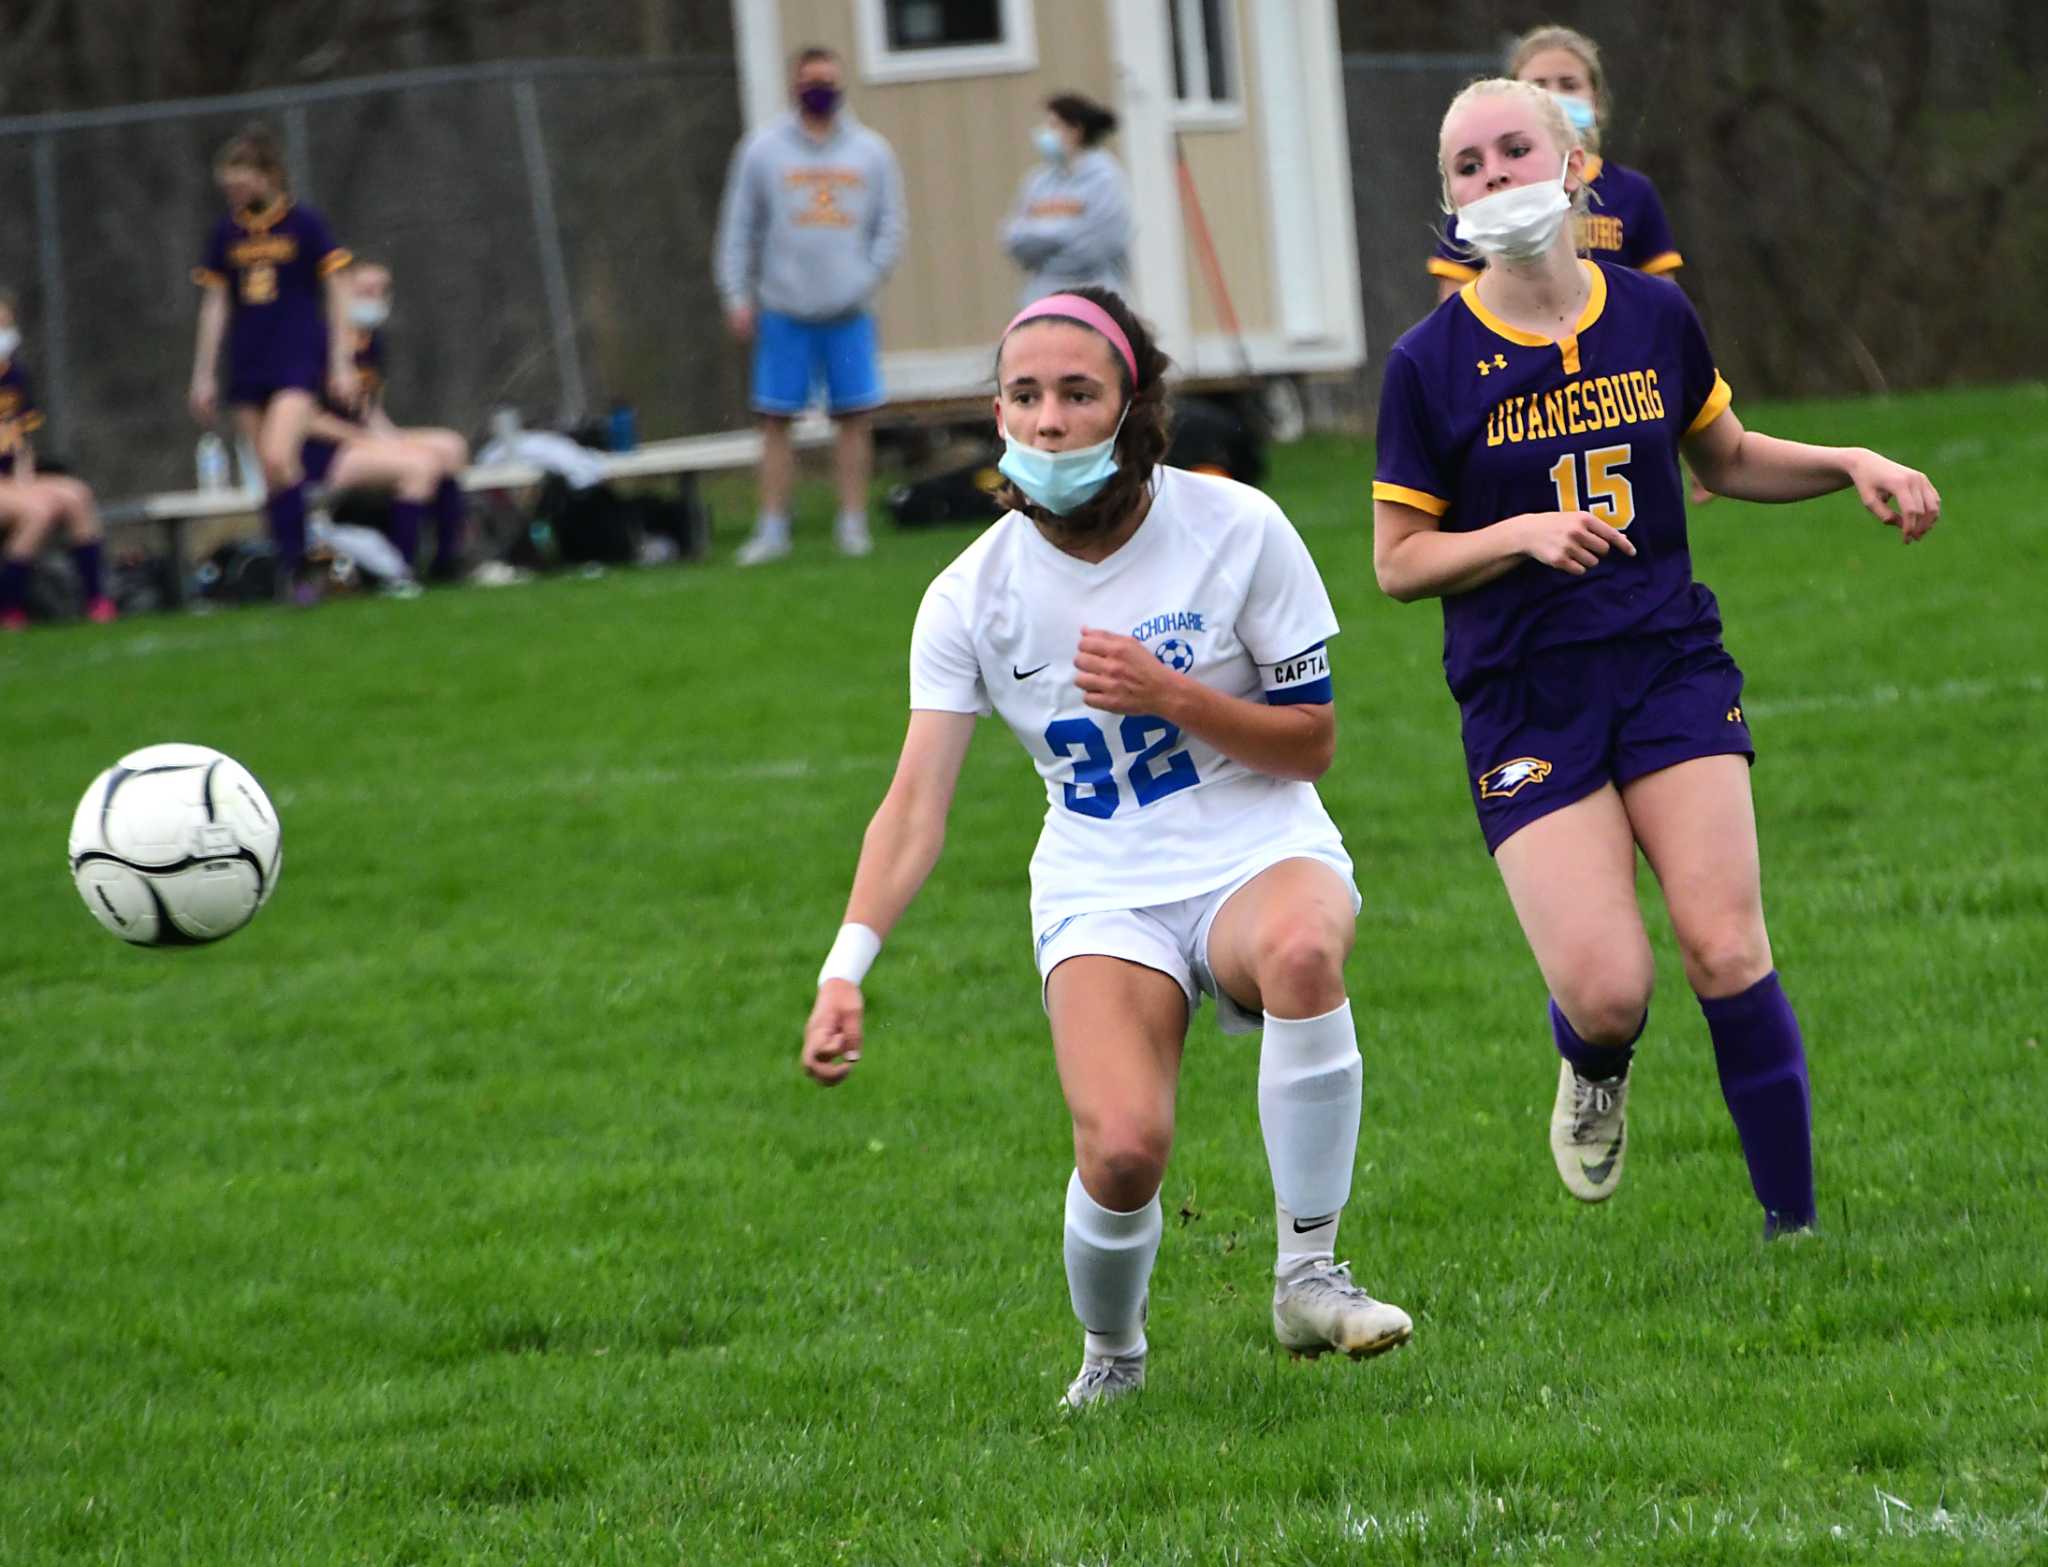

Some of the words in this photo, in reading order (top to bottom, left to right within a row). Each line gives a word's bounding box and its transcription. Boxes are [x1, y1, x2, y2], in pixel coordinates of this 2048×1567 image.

[1487, 368, 1664, 447] DUANESBURG
[1550, 443, 1635, 530] 15
[1044, 715, 1200, 819] 32
